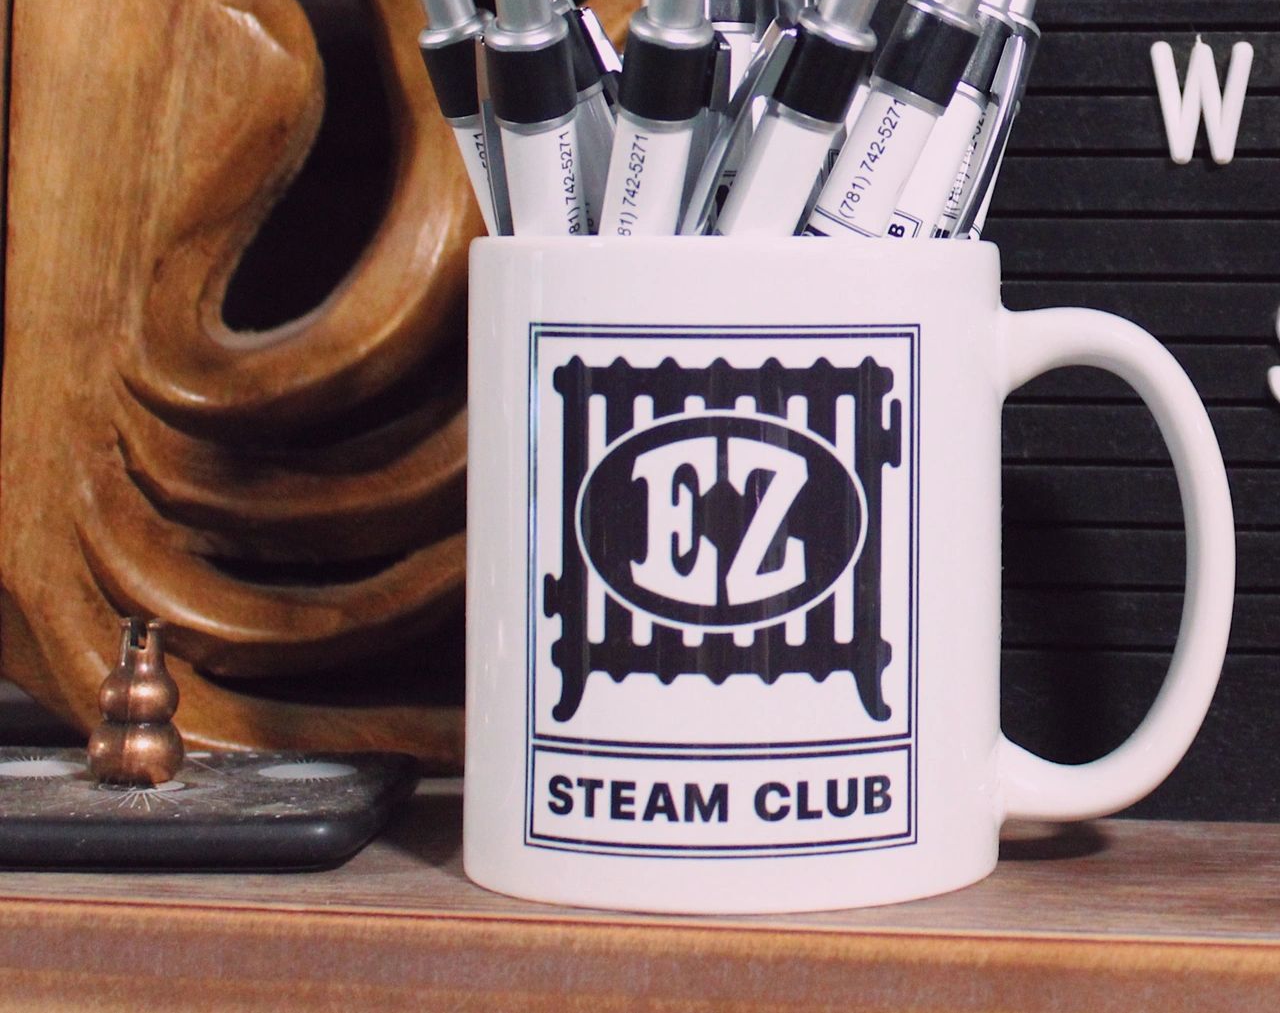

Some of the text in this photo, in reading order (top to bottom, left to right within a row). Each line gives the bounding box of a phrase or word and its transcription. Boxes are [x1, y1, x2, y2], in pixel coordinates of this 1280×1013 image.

[559, 131, 580, 236] 81) 742-5271
[618, 134, 649, 237] 81) 742-5271
[838, 176, 871, 219] (781)
[859, 98, 907, 174] 742-5271
[629, 436, 809, 607] EZ
[548, 775, 892, 823] STEAM CLUB
